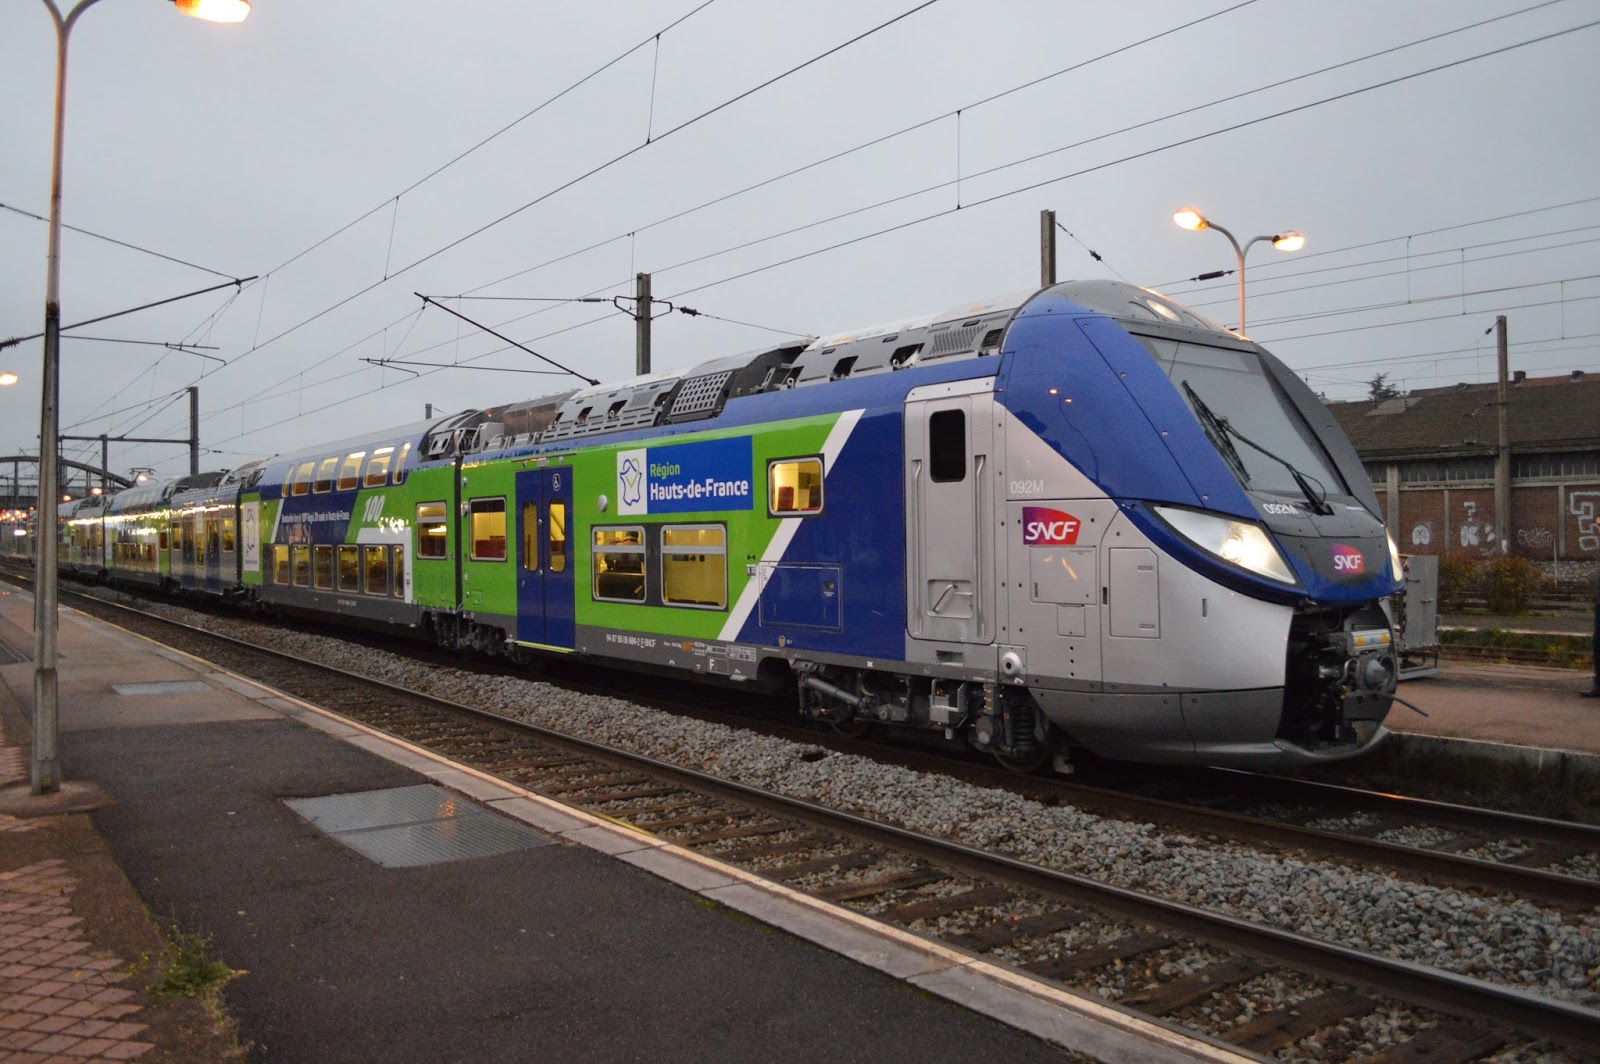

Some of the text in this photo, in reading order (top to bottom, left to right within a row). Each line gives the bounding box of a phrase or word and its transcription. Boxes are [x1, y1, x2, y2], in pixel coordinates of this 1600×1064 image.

[650, 462, 680, 479] Région
[650, 479, 748, 500] Hauts-de-France
[1010, 480, 1044, 494] 092M
[362, 495, 385, 522] 100
[1263, 503, 1299, 514] 092M
[1025, 521, 1077, 541] SNCF
[1334, 555, 1361, 570] SNCF
